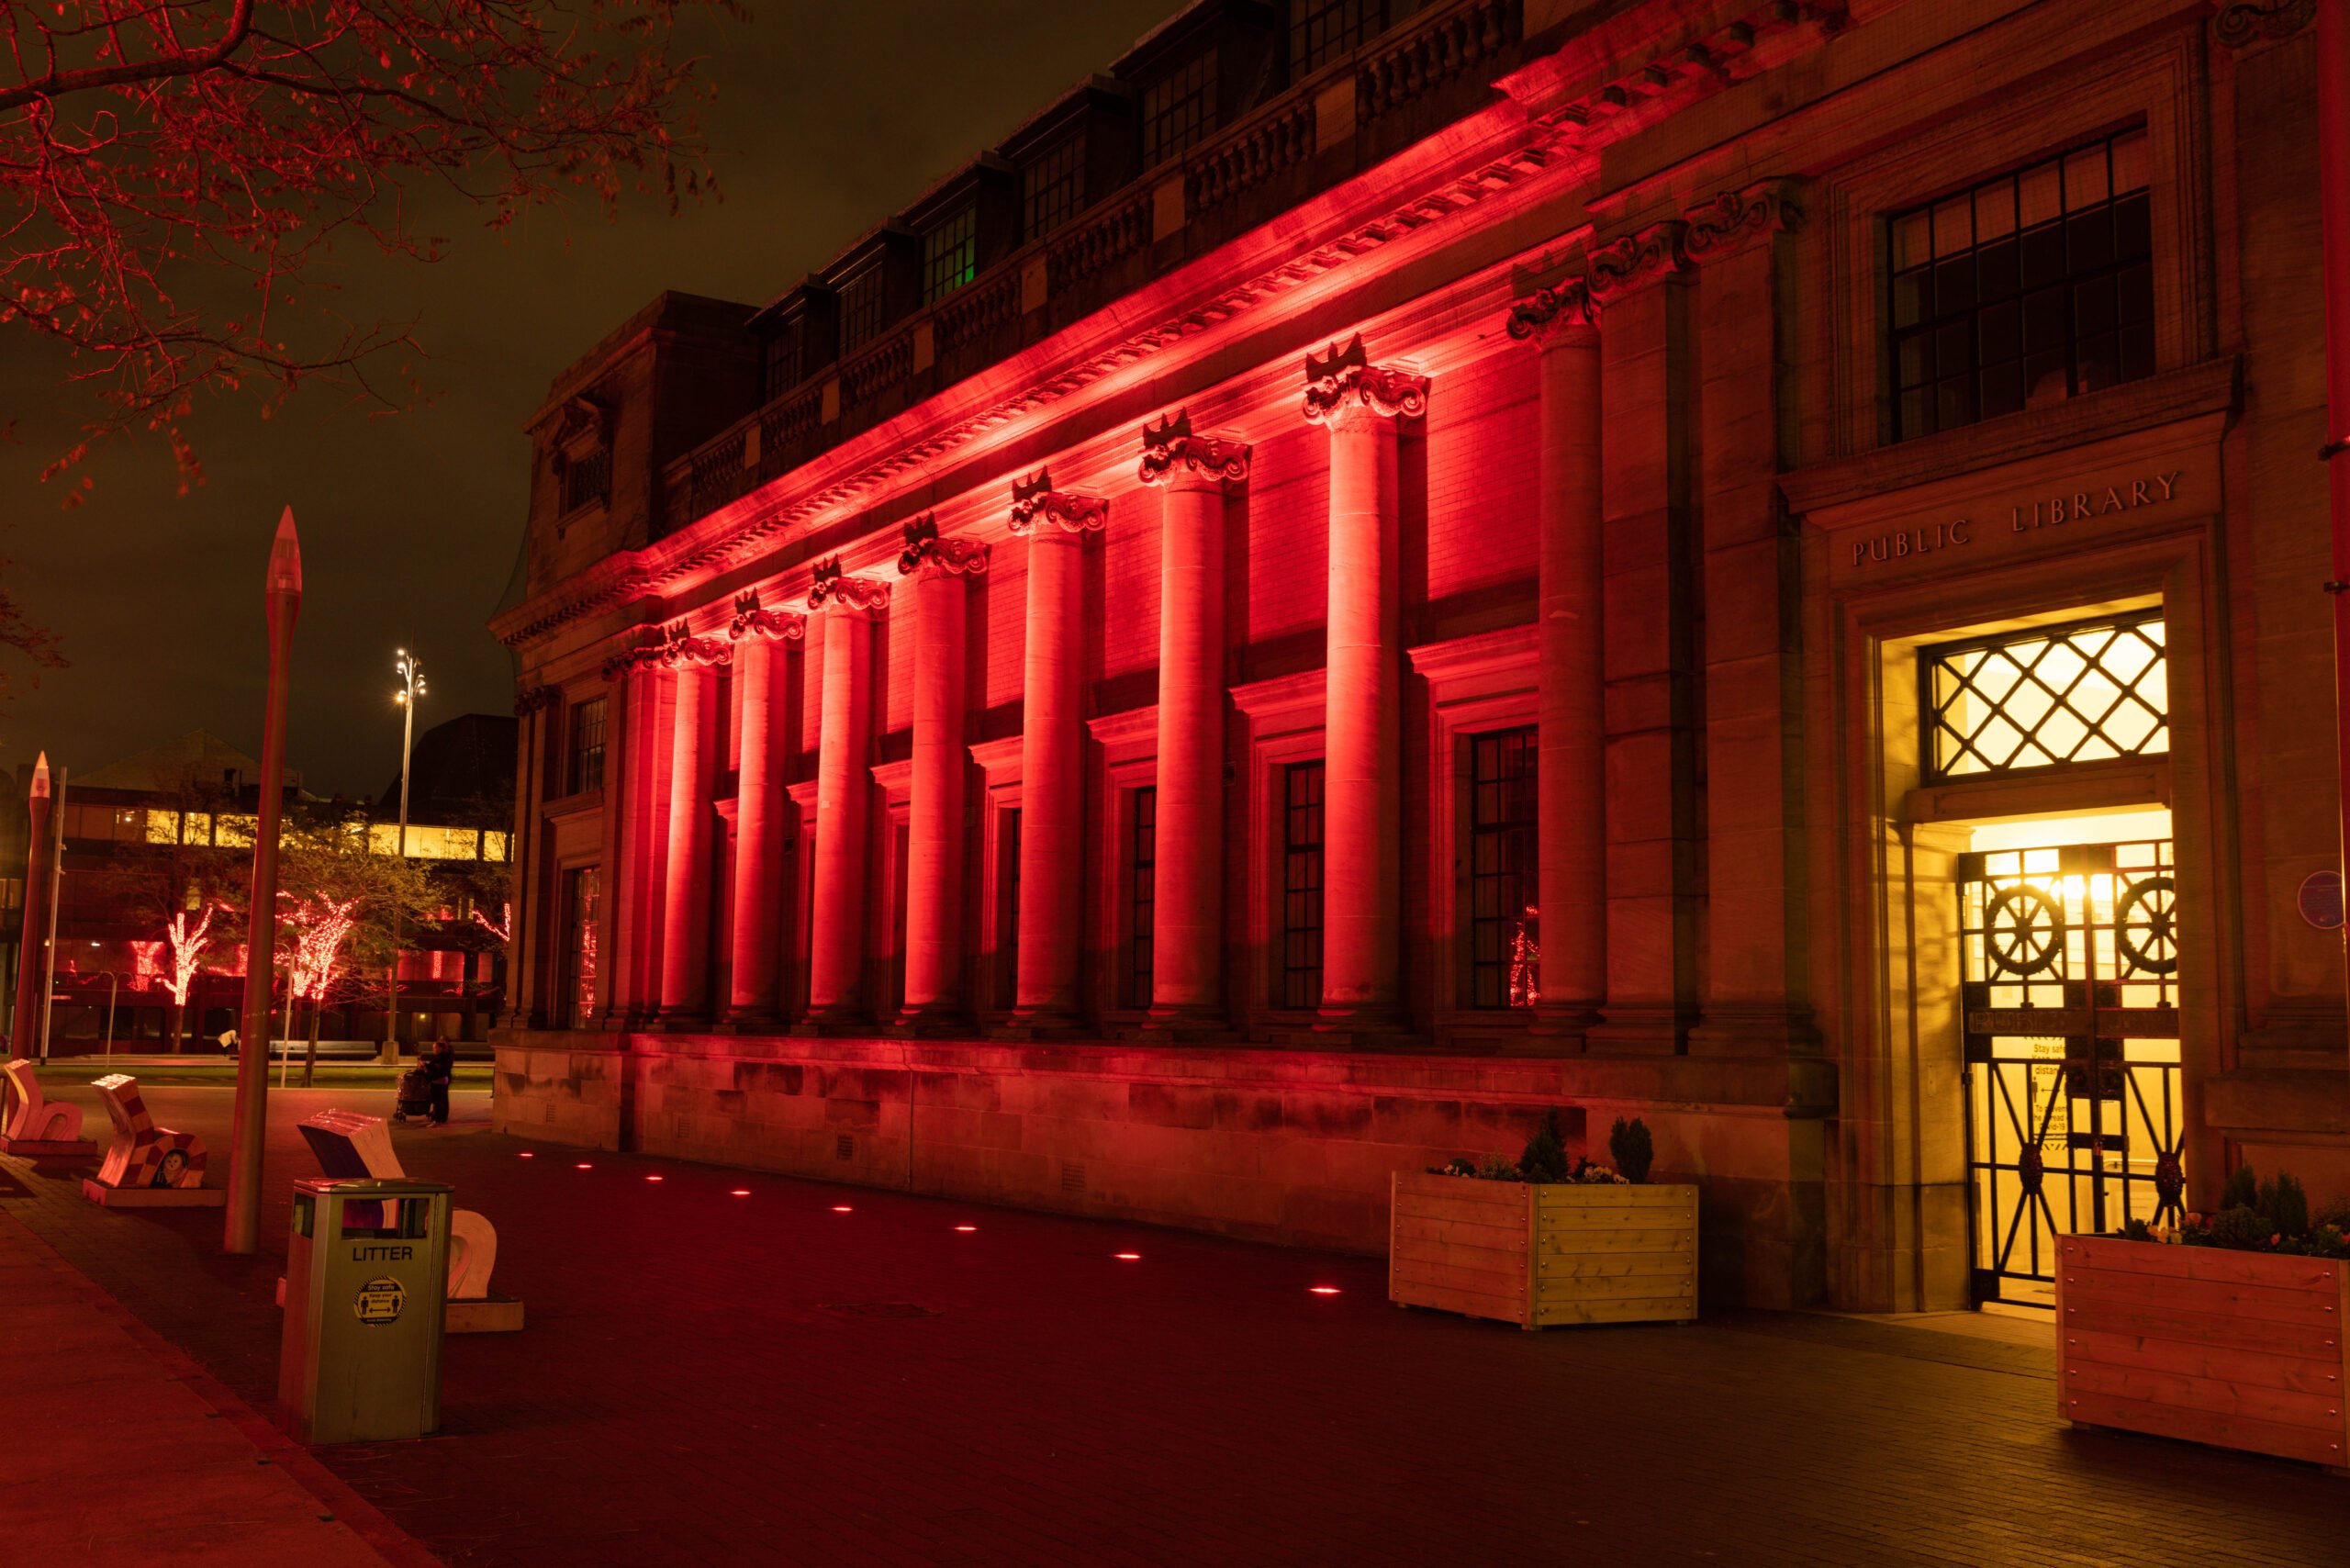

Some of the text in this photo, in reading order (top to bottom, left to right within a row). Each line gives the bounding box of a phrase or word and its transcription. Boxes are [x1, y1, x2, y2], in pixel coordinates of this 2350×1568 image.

[1852, 470, 2181, 566] PUBLIC LIBRARY
[2033, 1043, 2050, 1055] Stay
[2034, 1065, 2059, 1075] distan
[2032, 1114, 2042, 1122] he
[2039, 1122, 2065, 1131] Cvid-19
[352, 1246, 412, 1262] LITTER
